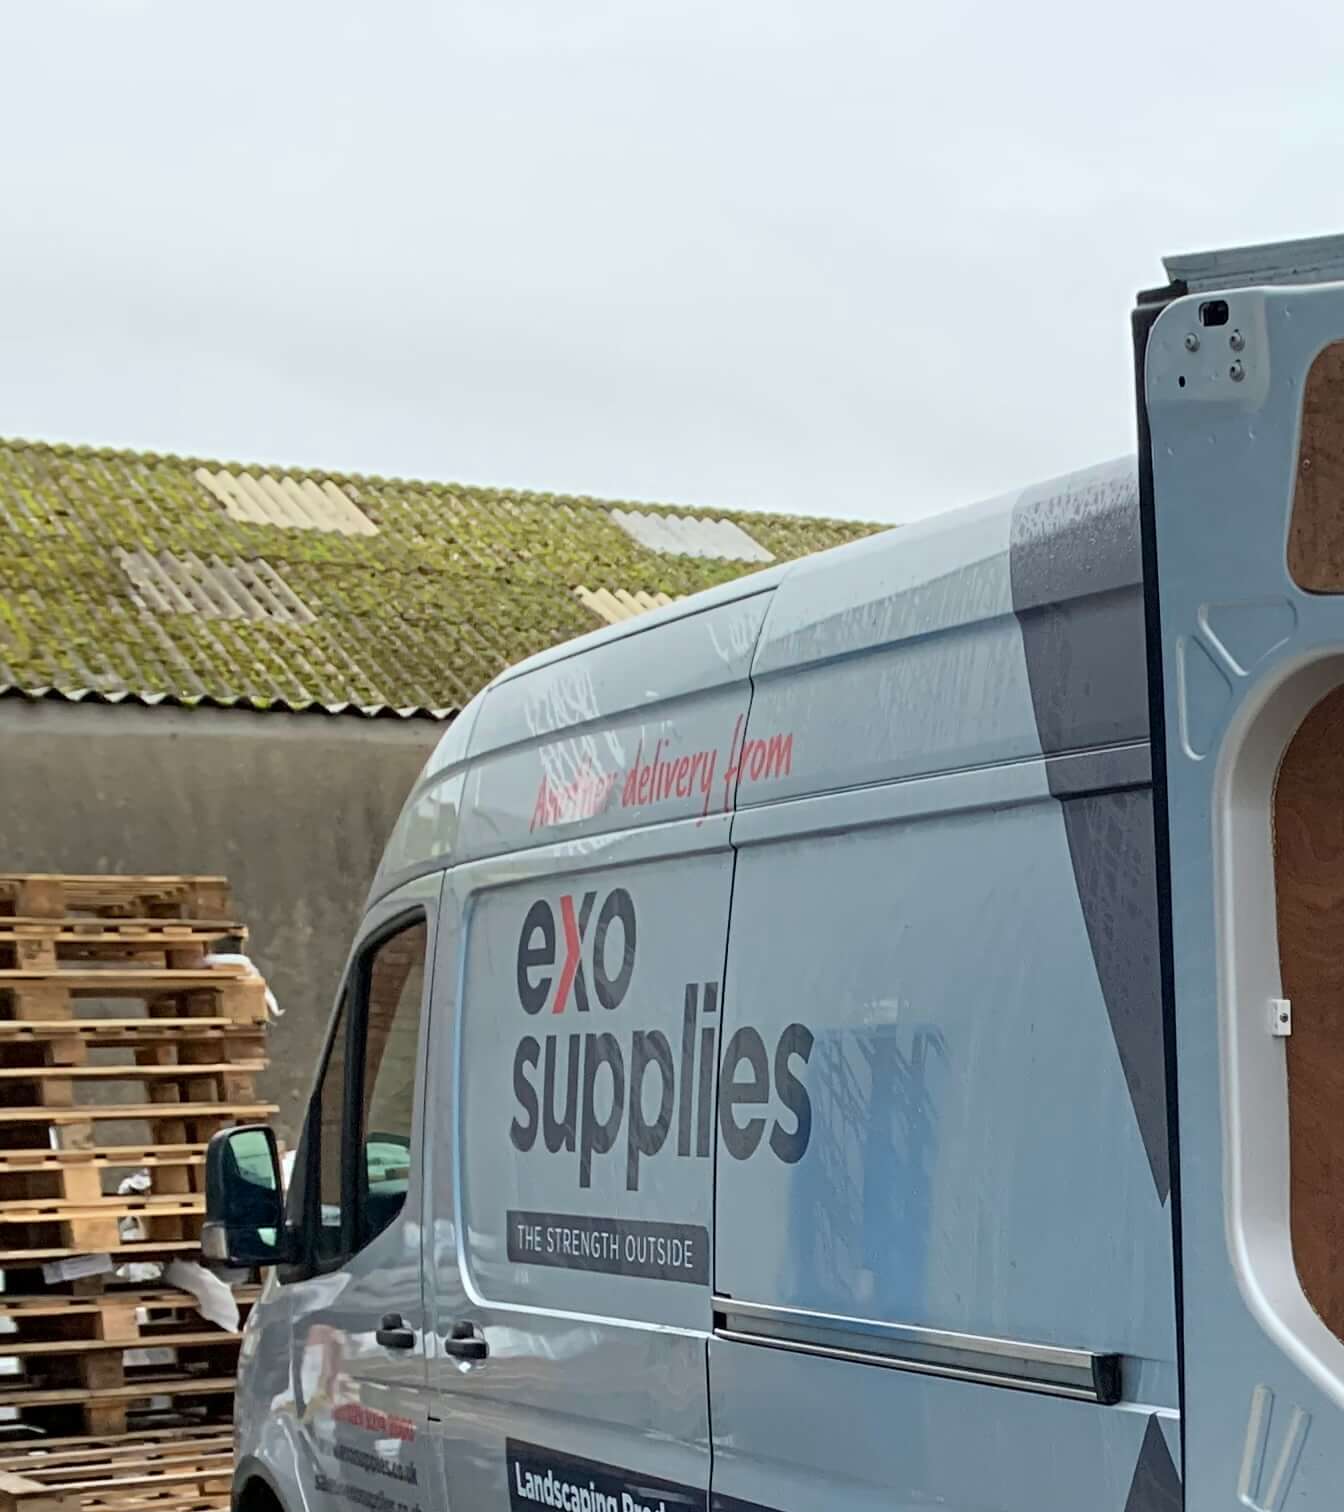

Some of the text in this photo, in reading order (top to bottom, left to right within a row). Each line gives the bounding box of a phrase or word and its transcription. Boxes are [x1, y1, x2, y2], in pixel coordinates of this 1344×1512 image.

[621, 738, 717, 828] delivery
[722, 713, 793, 821] from
[517, 888, 637, 1015] exo
[510, 981, 815, 1191] supplies
[517, 1225, 694, 1268] THE STRENGTH OUTSIDE
